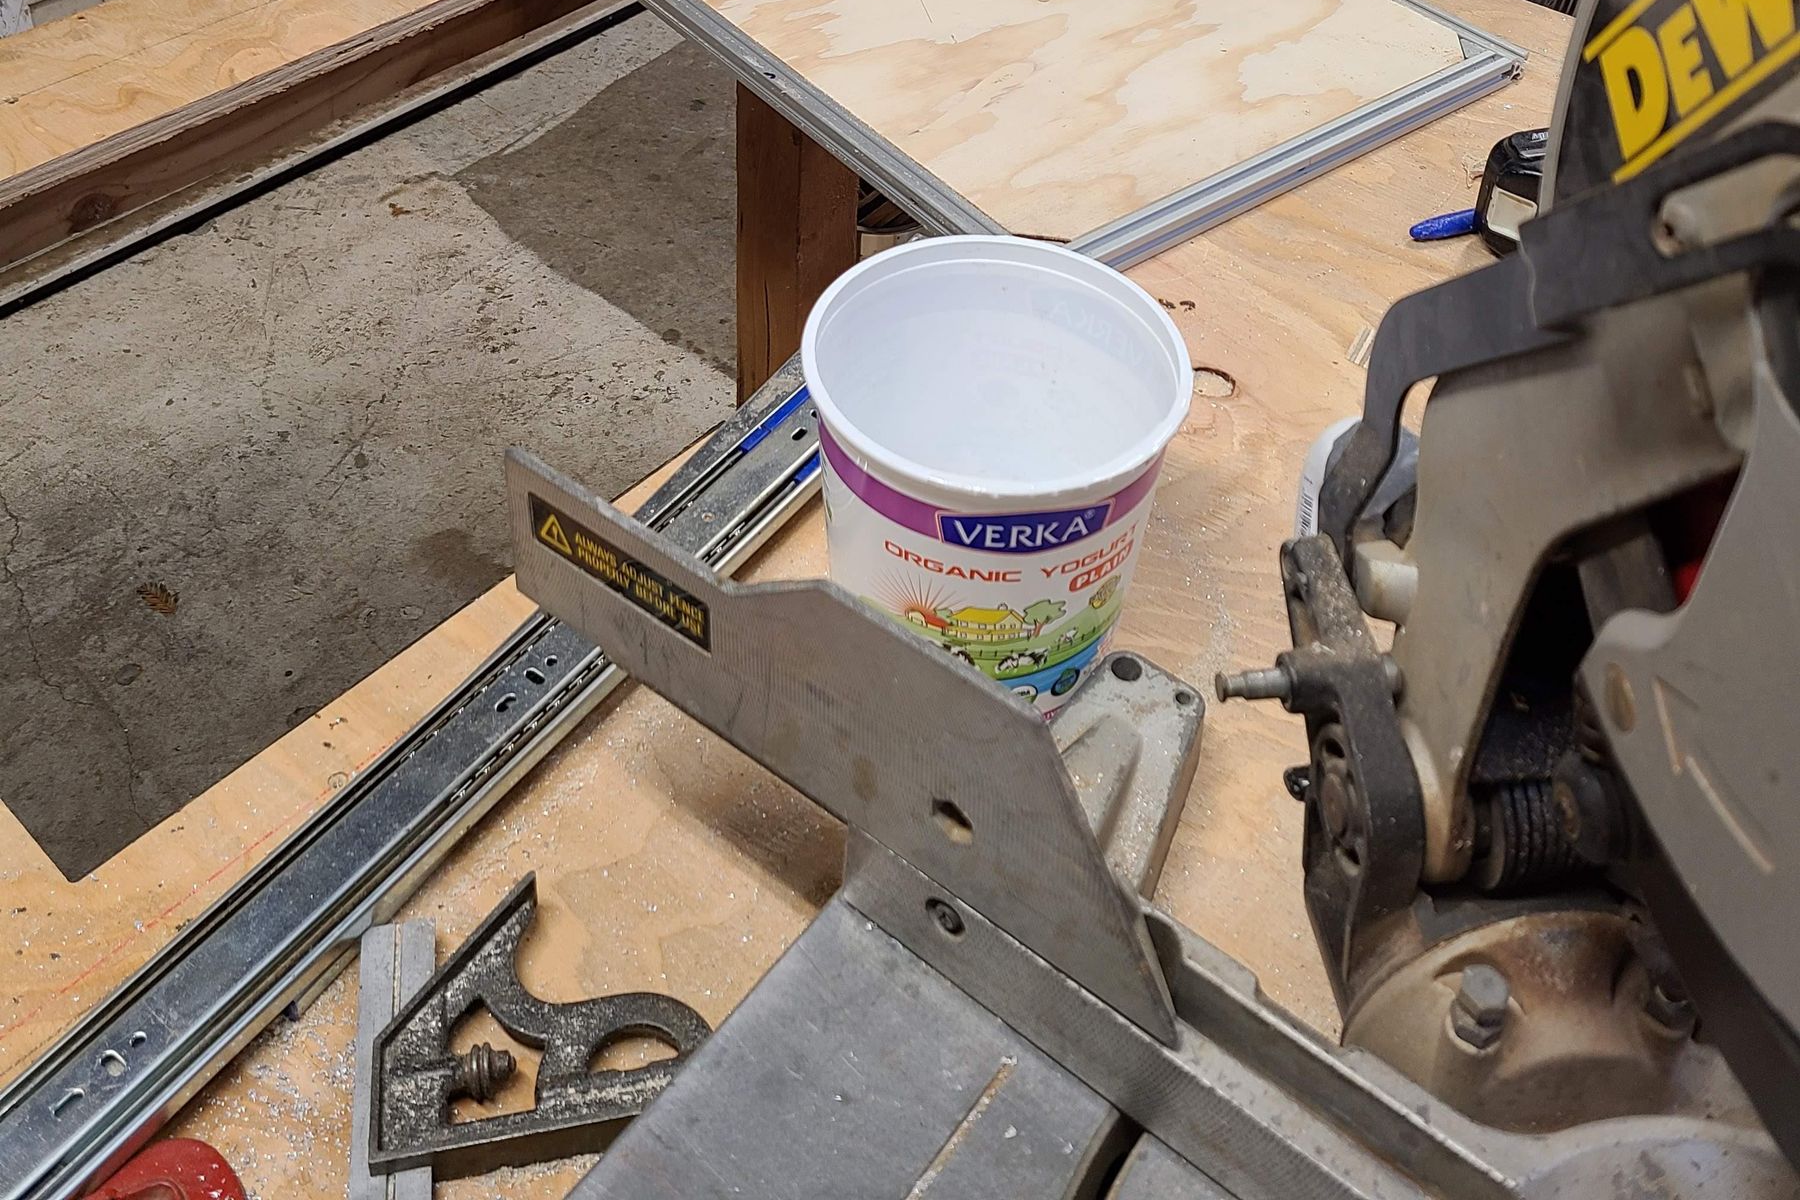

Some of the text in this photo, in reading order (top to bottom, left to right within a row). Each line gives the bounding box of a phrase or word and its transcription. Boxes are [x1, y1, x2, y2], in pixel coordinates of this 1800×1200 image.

[574, 531, 705, 622] ALWAYS ADJUST FENCE
[577, 548, 704, 638] PROPERLY BEFORE USE
[884, 539, 1022, 583] ORGANIC
[1074, 543, 1132, 590] PLAIN
